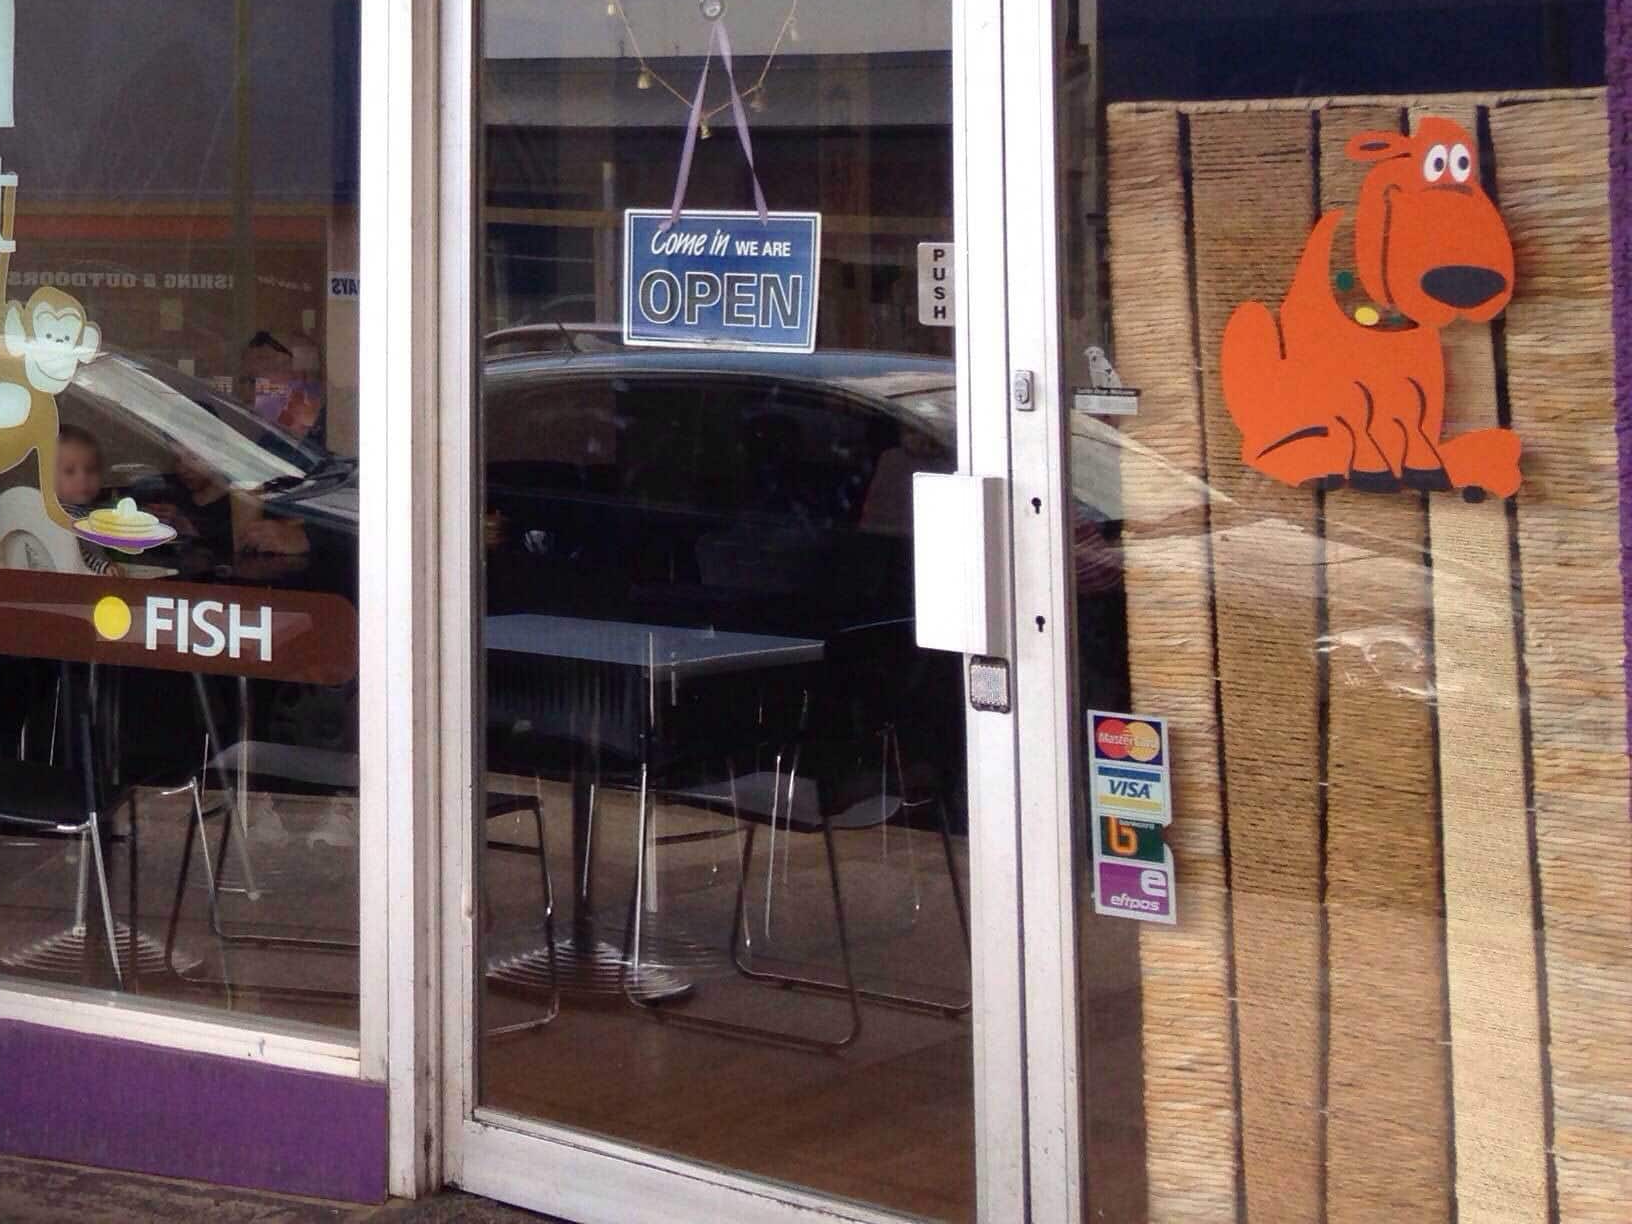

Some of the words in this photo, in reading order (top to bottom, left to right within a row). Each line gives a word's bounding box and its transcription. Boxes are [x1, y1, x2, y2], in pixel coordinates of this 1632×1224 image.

[651, 229, 708, 256] Come
[709, 229, 730, 257] in
[735, 240, 759, 256] WE
[761, 241, 792, 257] ARE
[638, 269, 803, 329] OPEN
[932, 248, 947, 319] PUSH
[144, 596, 273, 661] FISH
[1108, 779, 1152, 800] VISA
[1110, 892, 1161, 912] eftpos
